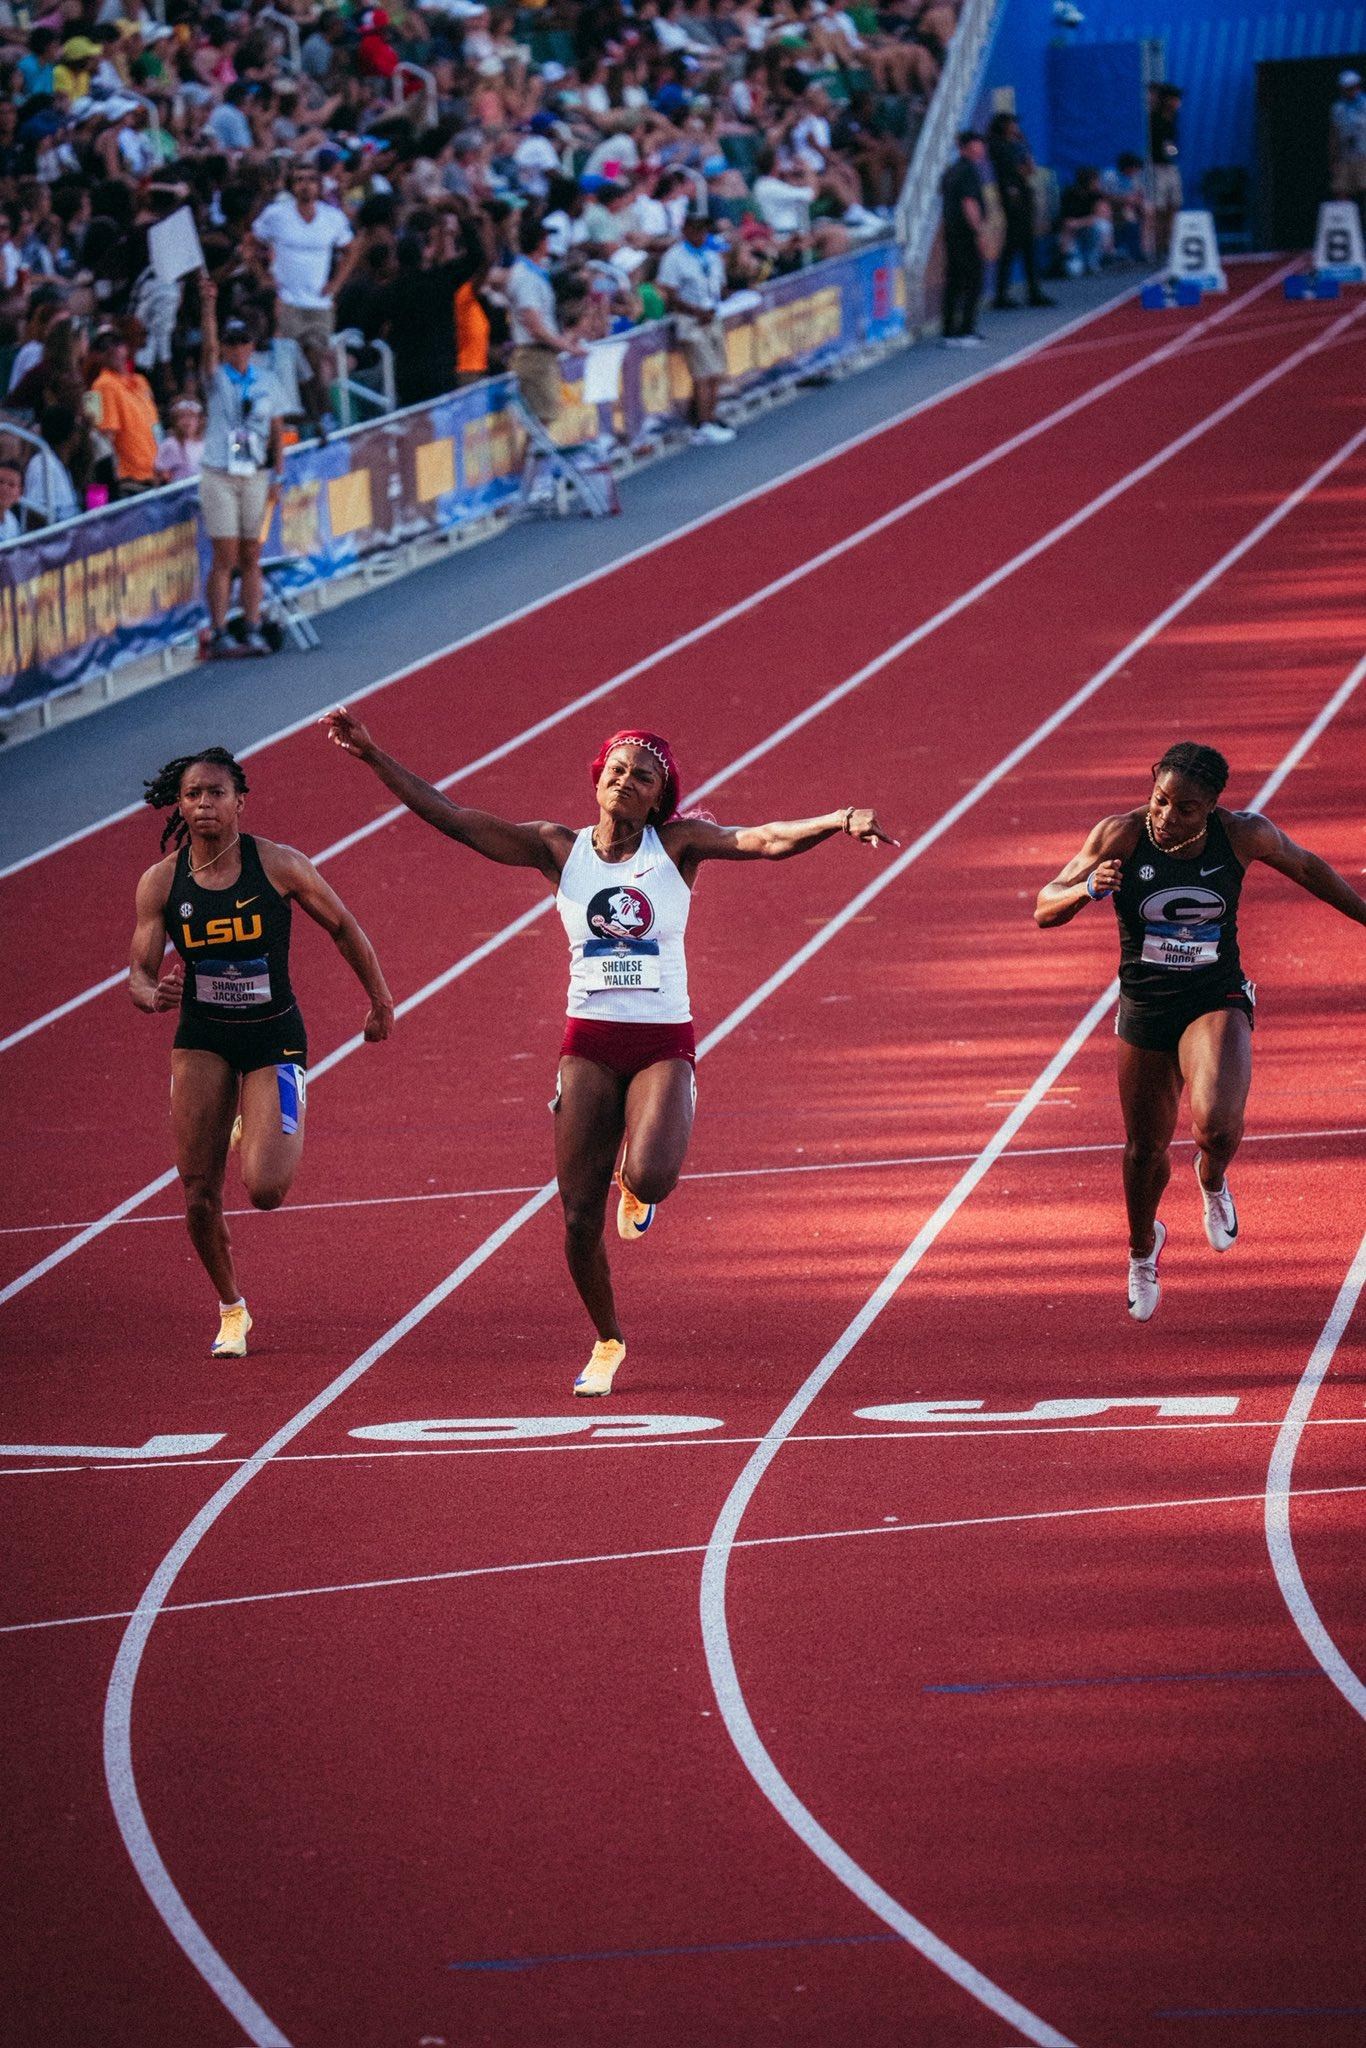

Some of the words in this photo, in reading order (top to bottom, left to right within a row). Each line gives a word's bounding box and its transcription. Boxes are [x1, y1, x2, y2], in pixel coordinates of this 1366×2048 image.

[1181, 235, 1206, 271] 9
[1139, 865, 1155, 880] SEC
[1140, 886, 1226, 925] G
[183, 915, 262, 948] LSU
[602, 960, 643, 973] SHENESE
[212, 981, 254, 992] SHAWNTI
[604, 974, 642, 986] WALKER
[212, 991, 255, 1002] JACKSON
[852, 1396, 1242, 1422] 5
[347, 1415, 725, 1441] 6
